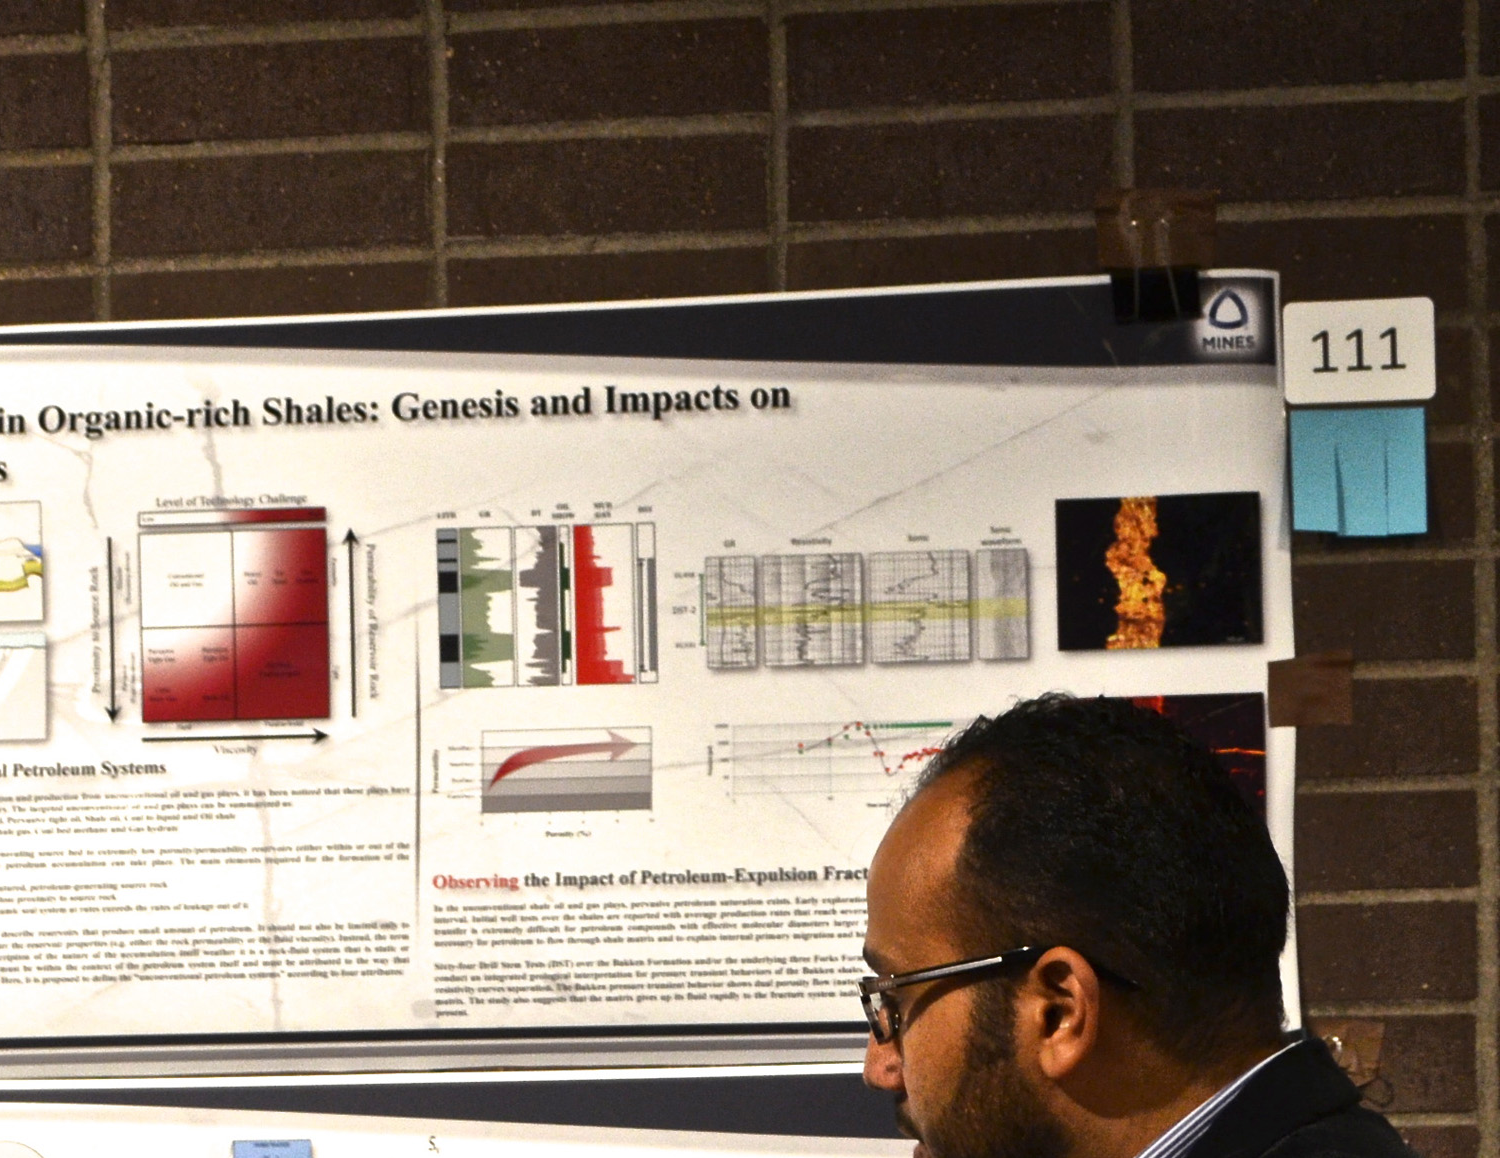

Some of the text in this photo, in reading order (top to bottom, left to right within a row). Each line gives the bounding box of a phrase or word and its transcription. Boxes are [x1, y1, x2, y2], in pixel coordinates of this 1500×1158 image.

[1202, 335, 1256, 350] MINES
[1311, 327, 1406, 374] 111
[38, 400, 250, 439] Organic-rich
[262, 396, 378, 425] Shales:
[391, 391, 520, 422] Genesis
[530, 386, 593, 417] and
[606, 386, 739, 420] Impacts
[750, 386, 791, 410] on
[156, 497, 183, 507] Level
[186, 497, 197, 506] of
[259, 494, 308, 506] Challenge
[12, 762, 96, 778] Petroleum
[100, 760, 166, 779] Systems
[432, 874, 520, 892] Observing
[523, 872, 550, 889] the
[554, 871, 614, 891] Impact
[618, 869, 637, 887] of
[640, 867, 818, 886] Petroleum-Expulsion
